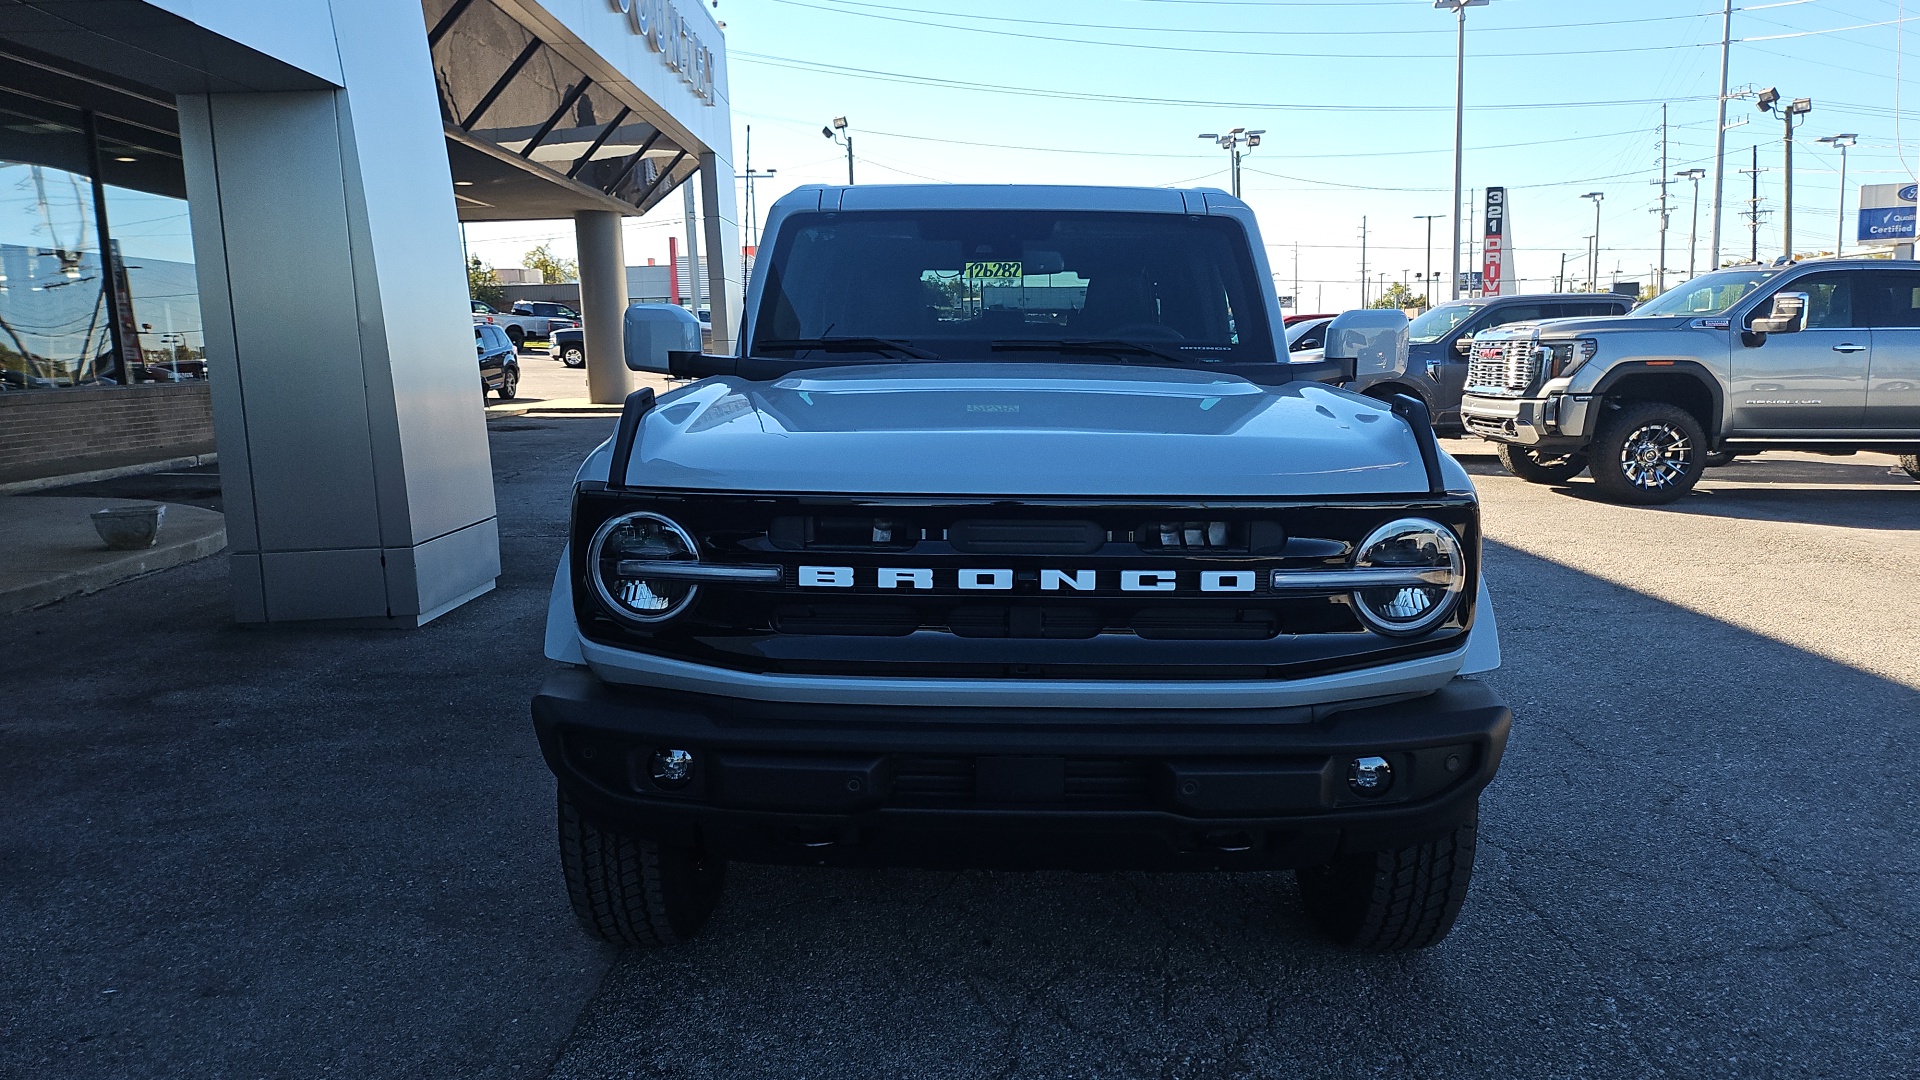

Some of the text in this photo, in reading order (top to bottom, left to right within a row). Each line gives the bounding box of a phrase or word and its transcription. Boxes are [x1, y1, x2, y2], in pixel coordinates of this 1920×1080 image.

[610, 0, 715, 106] UNTRY
[1487, 191, 1503, 232] 321
[1893, 214, 1916, 222] Qualit
[1869, 224, 1913, 234] Certified
[798, 565, 1257, 592] BRONCO
